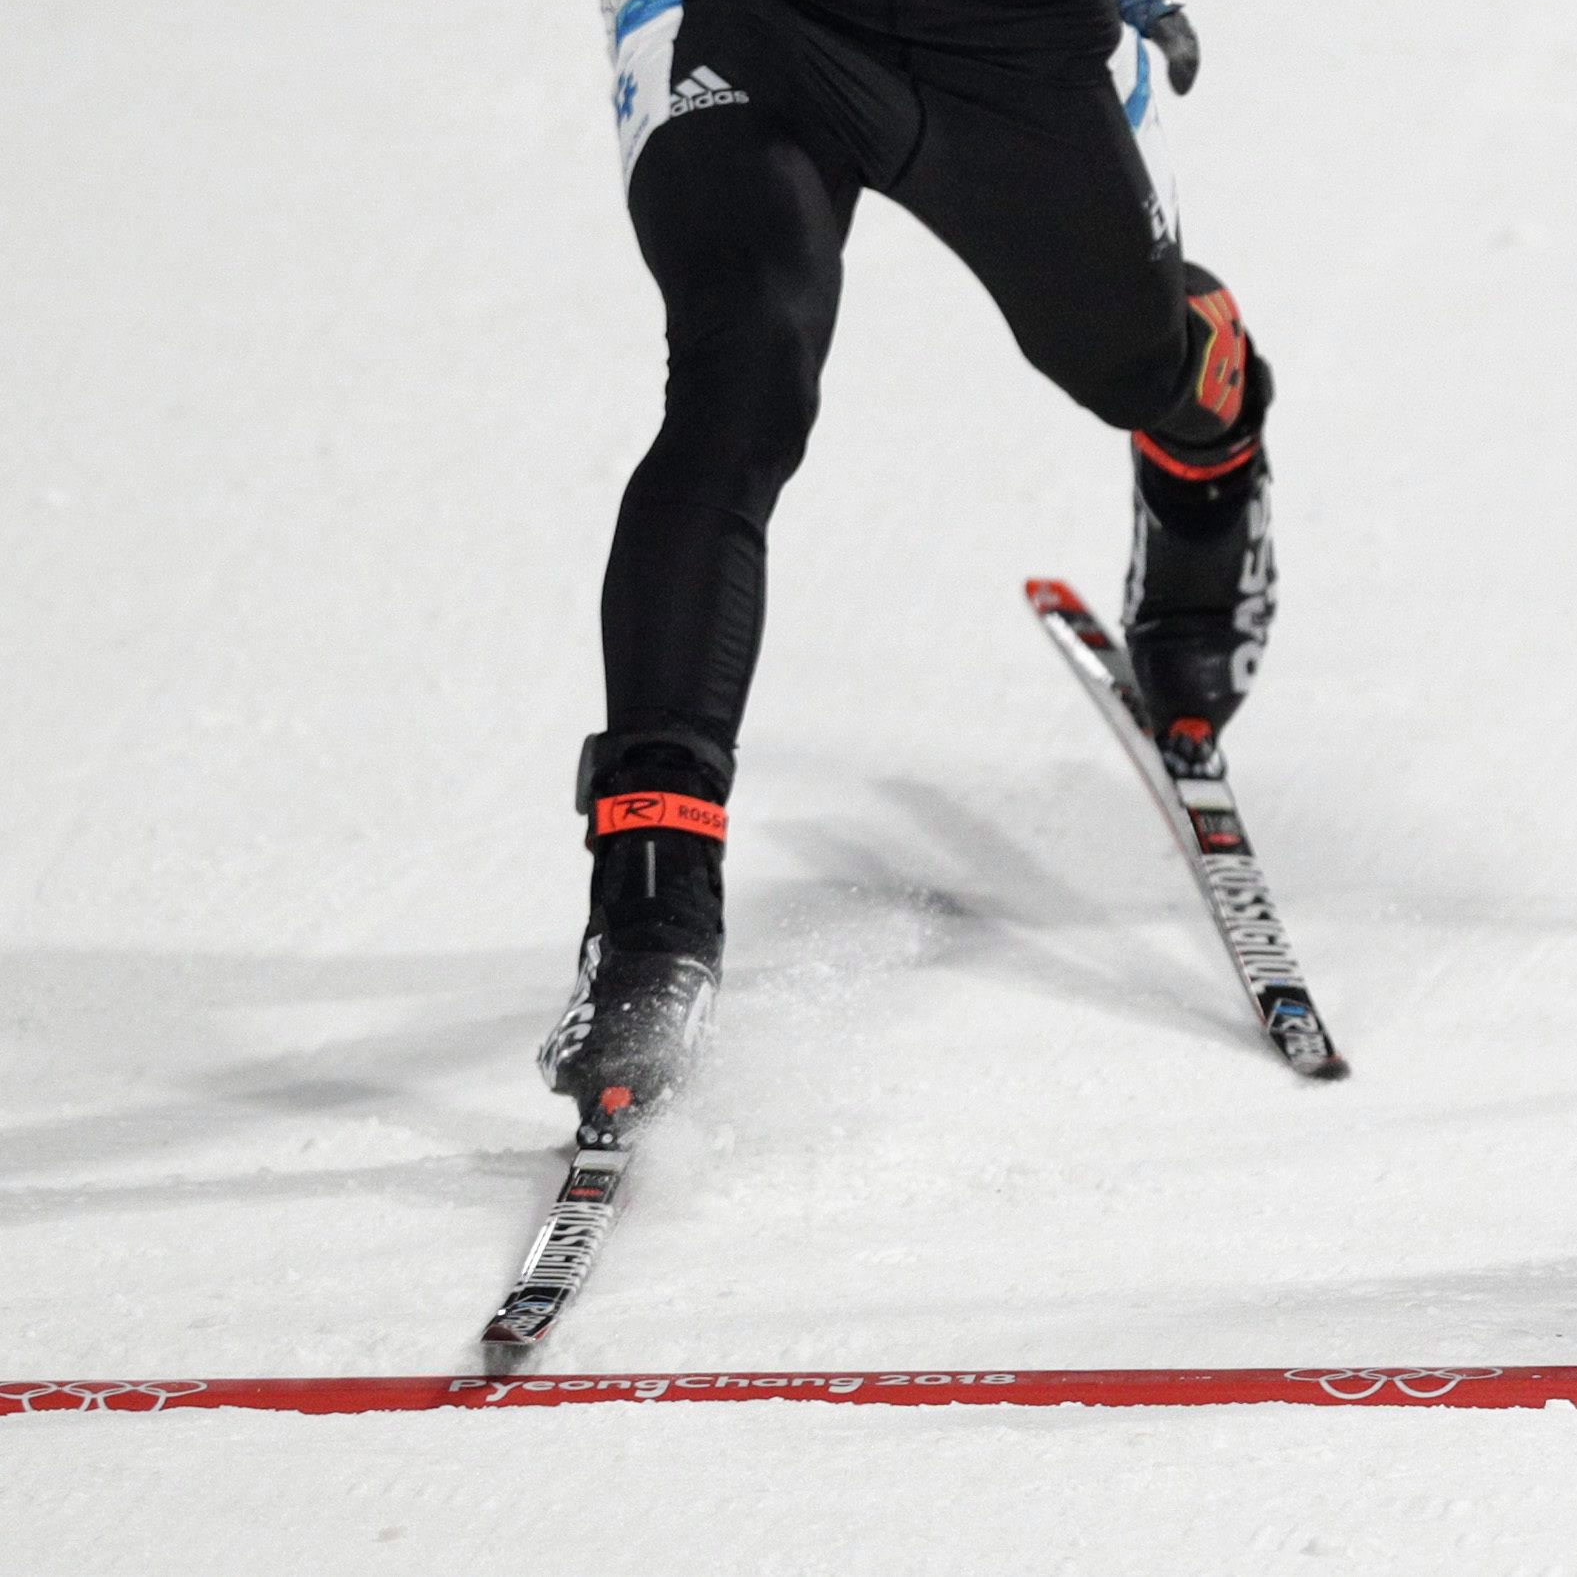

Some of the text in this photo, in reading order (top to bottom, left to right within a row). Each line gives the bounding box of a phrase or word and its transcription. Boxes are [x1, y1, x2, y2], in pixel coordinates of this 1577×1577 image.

[671, 90, 750, 117] didas
[448, 1373, 1018, 1401] PyeongChang 2018
